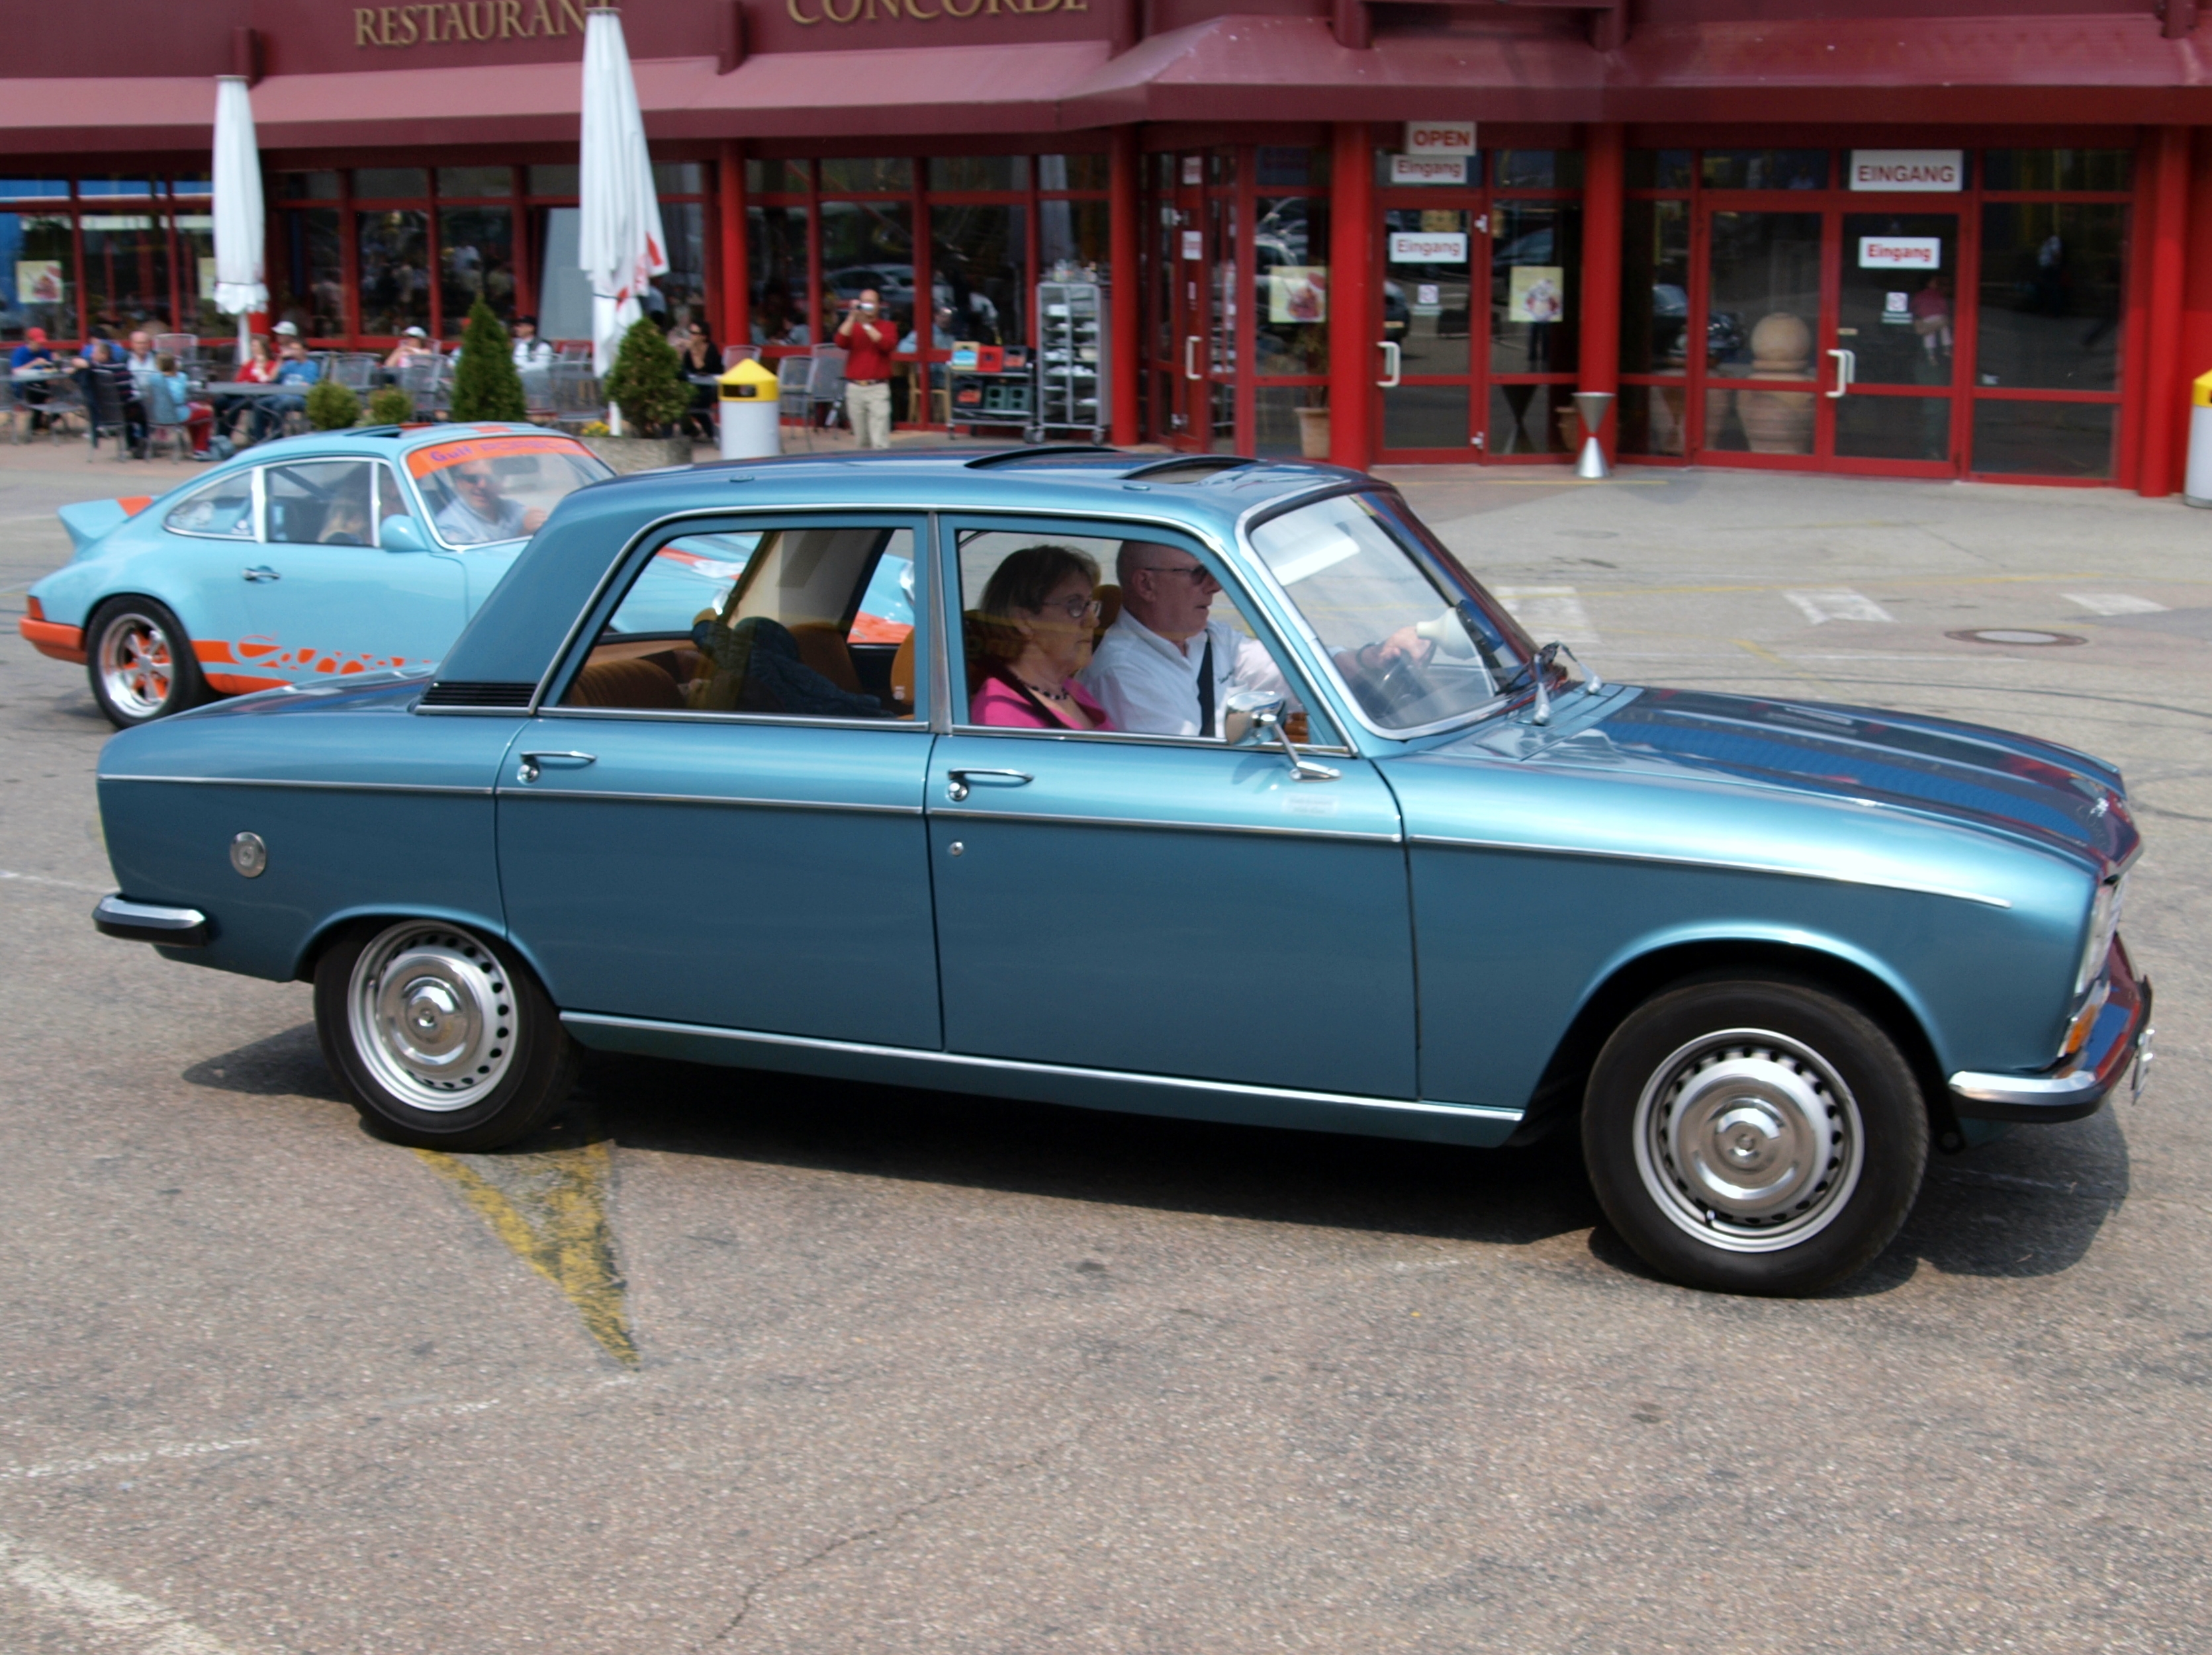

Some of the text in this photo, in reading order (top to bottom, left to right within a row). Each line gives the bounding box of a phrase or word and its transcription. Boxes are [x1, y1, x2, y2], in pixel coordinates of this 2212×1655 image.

[786, 0, 1087, 24] CONC
[353, 0, 608, 46] RESTAURAN
[1414, 130, 1470, 146] OPEN
[1397, 160, 1461, 177] Eingang
[1858, 165, 1954, 182] EINGANG
[1397, 239, 1461, 257] Eingang
[1868, 244, 1932, 261] Eingang
[430, 445, 473, 461] Gulf
[229, 631, 434, 675] Carre
